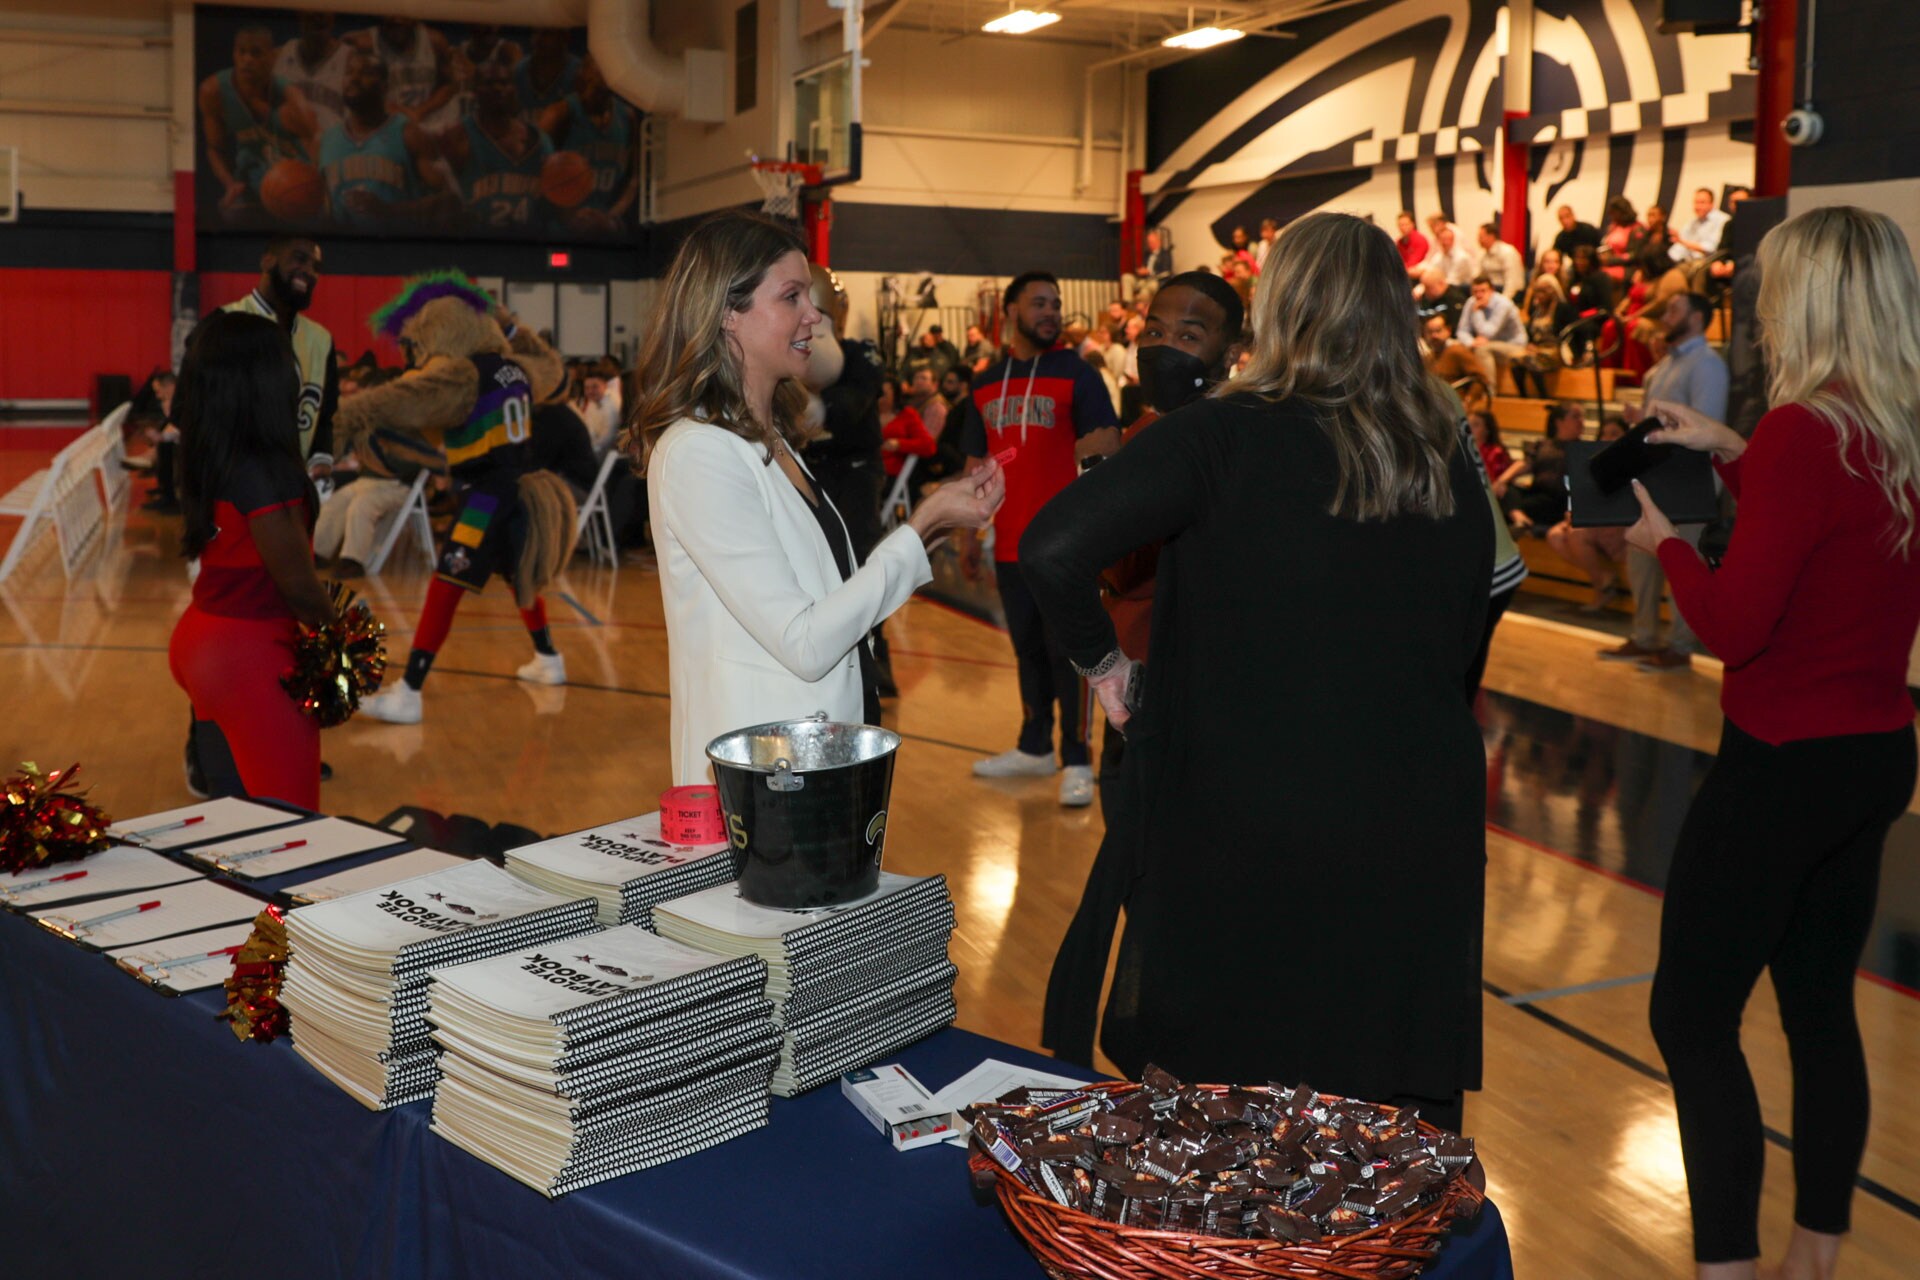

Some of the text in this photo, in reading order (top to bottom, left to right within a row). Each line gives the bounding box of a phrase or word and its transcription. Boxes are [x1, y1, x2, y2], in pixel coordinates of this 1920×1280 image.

[678, 810, 702, 818] TICKET
[579, 842, 662, 865] EMPLOYEE
[581, 834, 686, 864] PLAYBOOK
[376, 901, 458, 933] EMPLOYEE
[379, 890, 475, 929] LAYBOOK
[520, 963, 609, 997] EMPLOYEE
[523, 953, 631, 993] LAYBOOK
